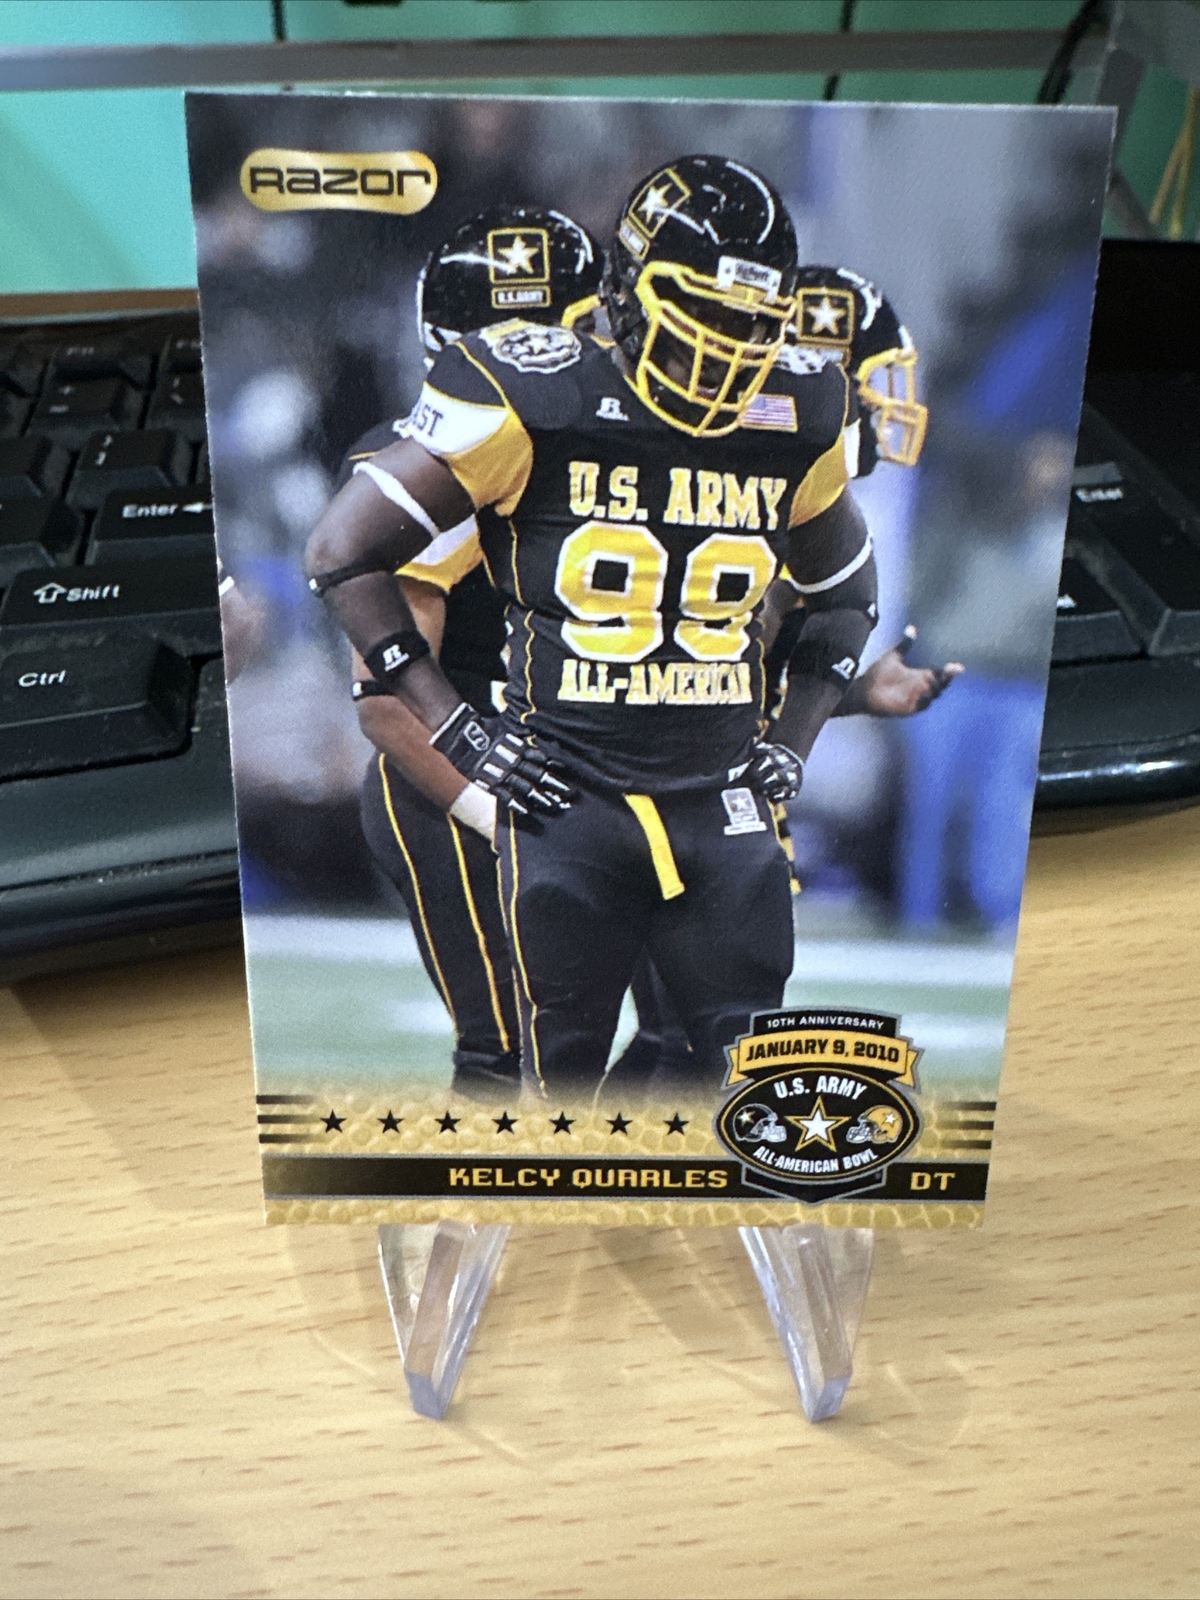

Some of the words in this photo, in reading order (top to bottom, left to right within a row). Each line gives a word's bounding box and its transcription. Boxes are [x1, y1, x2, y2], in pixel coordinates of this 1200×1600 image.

[250, 167, 431, 197] Razor
[568, 460, 649, 521] U.S.
[663, 467, 788, 531] ARMY
[121, 502, 179, 519] Enter
[66, 584, 121, 603] Shift
[554, 520, 778, 664] 99
[18, 669, 67, 688] Ctrl
[766, 1017, 796, 1029] 10TH
[799, 1015, 885, 1030] ANNIVERSARY
[745, 1038, 829, 1062] JANUARY
[832, 1039, 850, 1058] 9,
[853, 1041, 900, 1063] 2010
[773, 1077, 810, 1099] U.S.
[816, 1075, 868, 1100] ARMY
[753, 1145, 840, 1173] ALL-AMERICAN
[843, 1147, 879, 1170] BOWL
[449, 1167, 561, 1187] KELCY
[571, 1168, 729, 1189] QUARLES
[910, 1171, 956, 1191] DT
